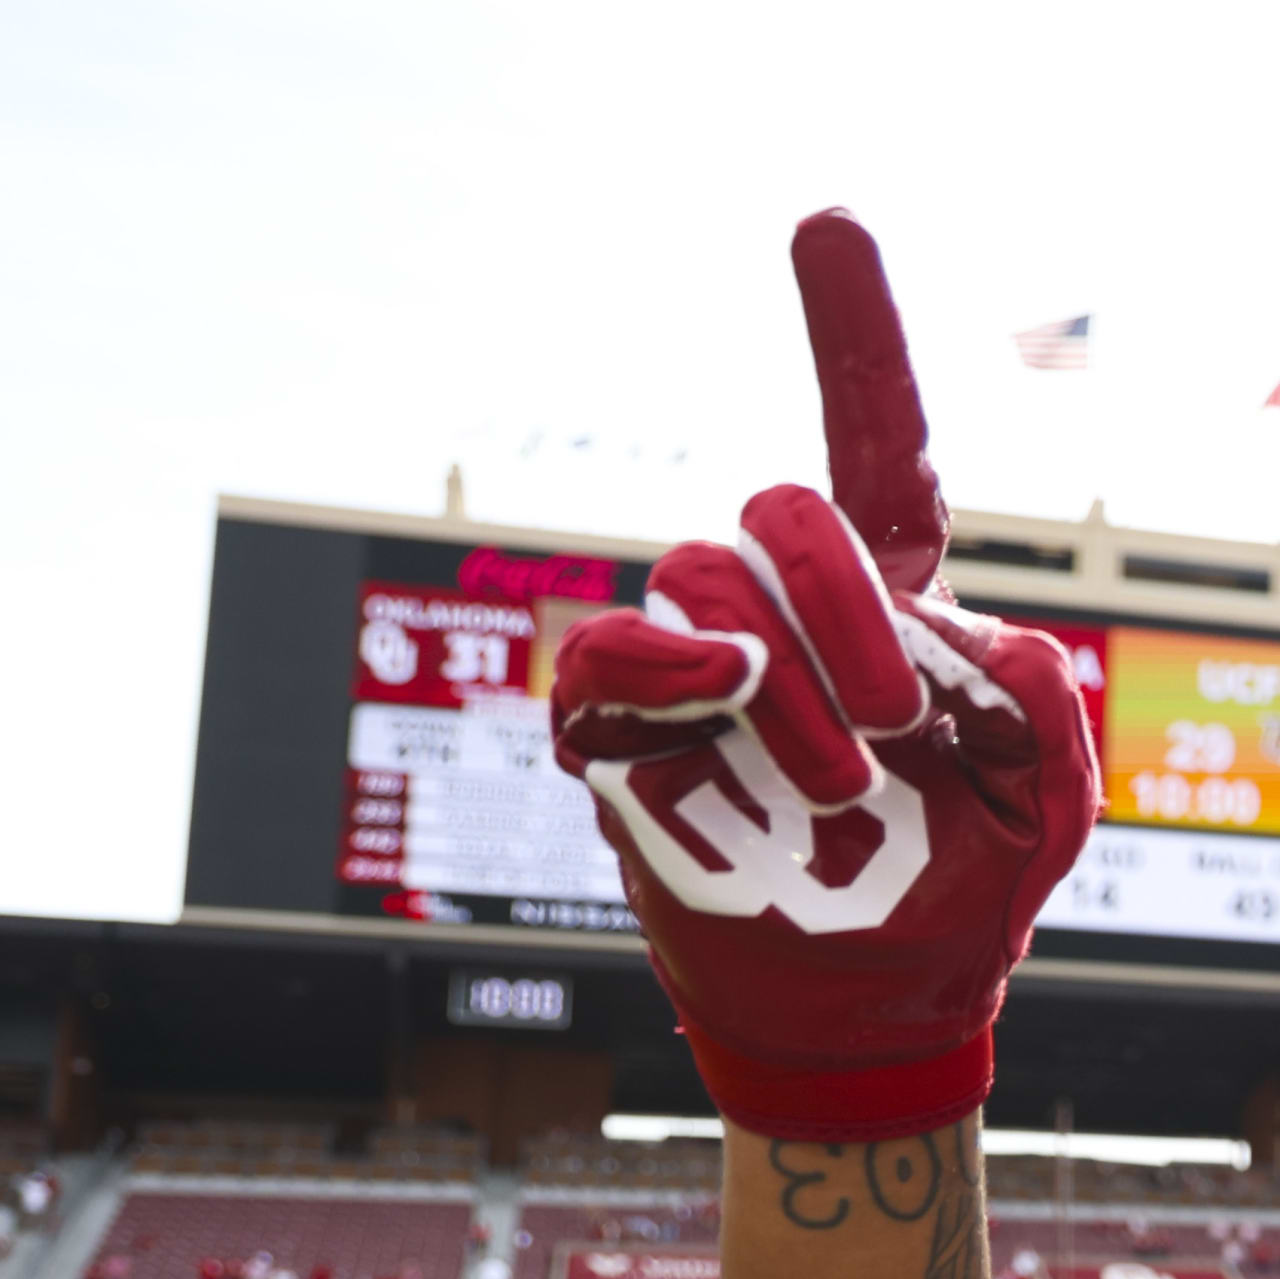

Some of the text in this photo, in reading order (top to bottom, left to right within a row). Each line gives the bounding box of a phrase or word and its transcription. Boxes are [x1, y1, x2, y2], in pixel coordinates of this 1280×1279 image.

[363, 594, 536, 639] OKLAHOMA
[440, 631, 510, 684] 31
[1164, 720, 1236, 774] 29
